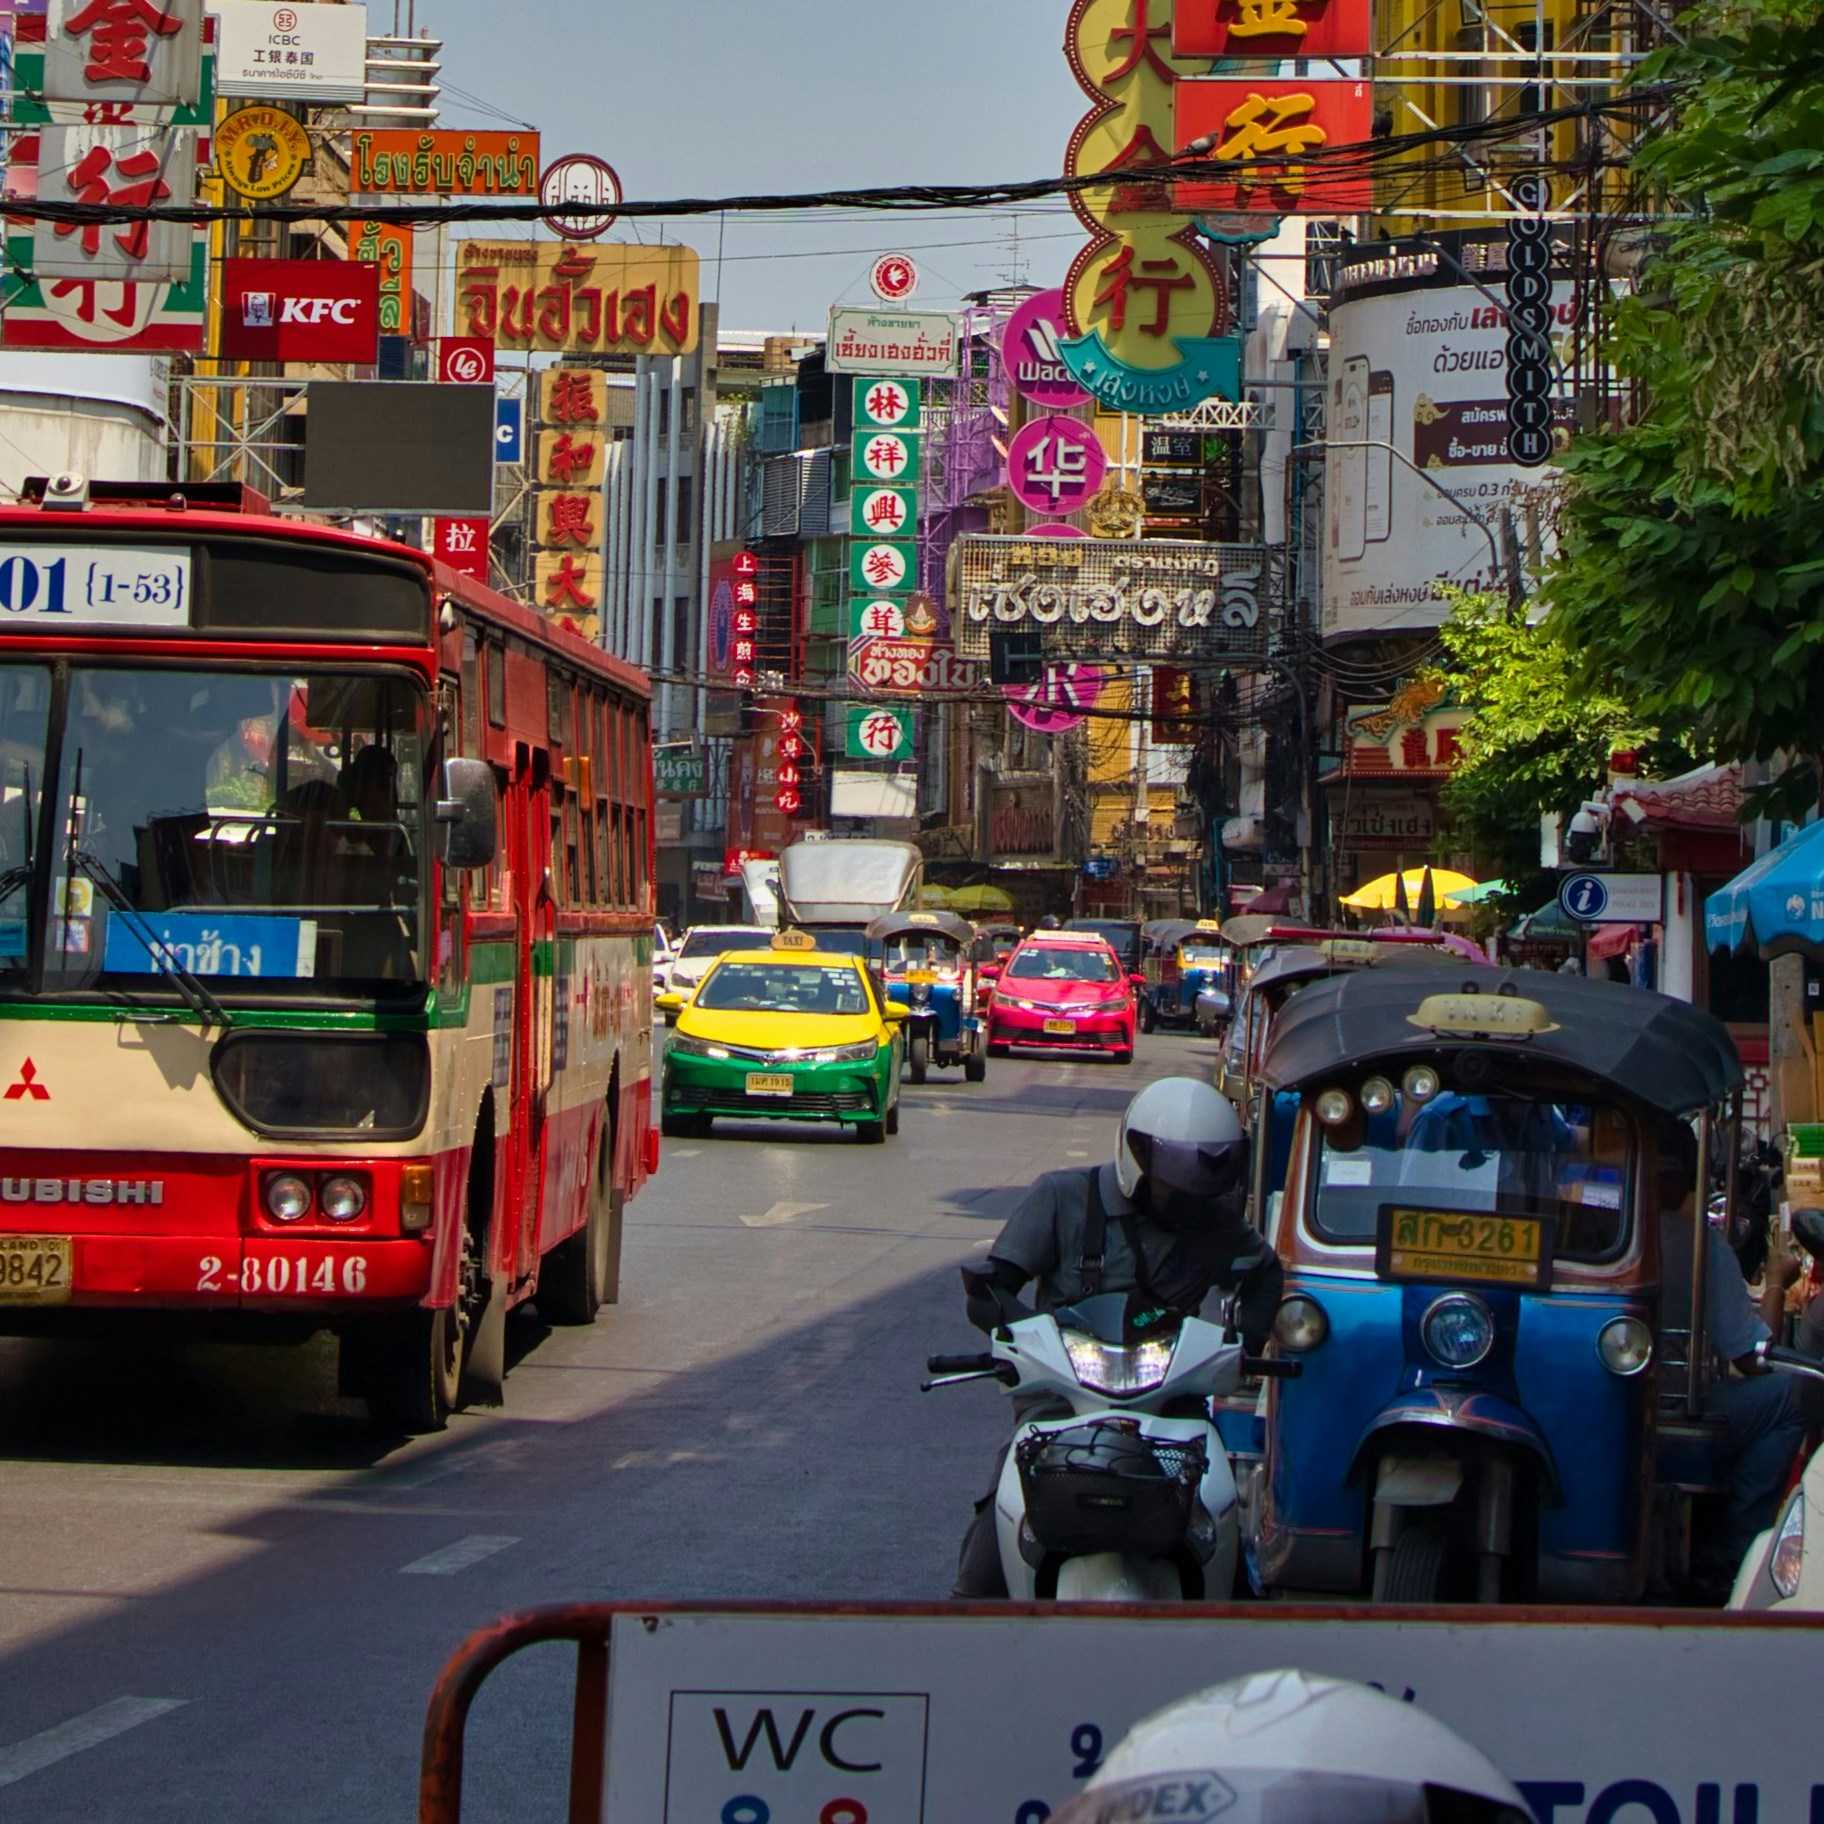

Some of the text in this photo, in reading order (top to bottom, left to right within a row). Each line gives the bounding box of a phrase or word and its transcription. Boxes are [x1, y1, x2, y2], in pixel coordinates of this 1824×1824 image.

[268, 34, 301, 46] ICBC
[252, 49, 315, 66] 工银泰国
[356, 132, 537, 189] โรงรับจำนำ
[224, 159, 298, 193] Always Low Prices
[459, 246, 691, 346] จินฮั้วเฮง
[279, 298, 357, 325] KFC
[1405, 310, 1470, 336] ซื้อทองกับ
[1478, 482, 1498, 497] 0.3
[868, 641, 927, 661] ห้างทอง
[859, 644, 977, 690] ทองใบ
[782, 935, 805, 947] TAXI
[1456, 1216, 1535, 1255] 3261
[196, 1255, 368, 1295] 2-80146
[712, 1706, 886, 1773] WC
